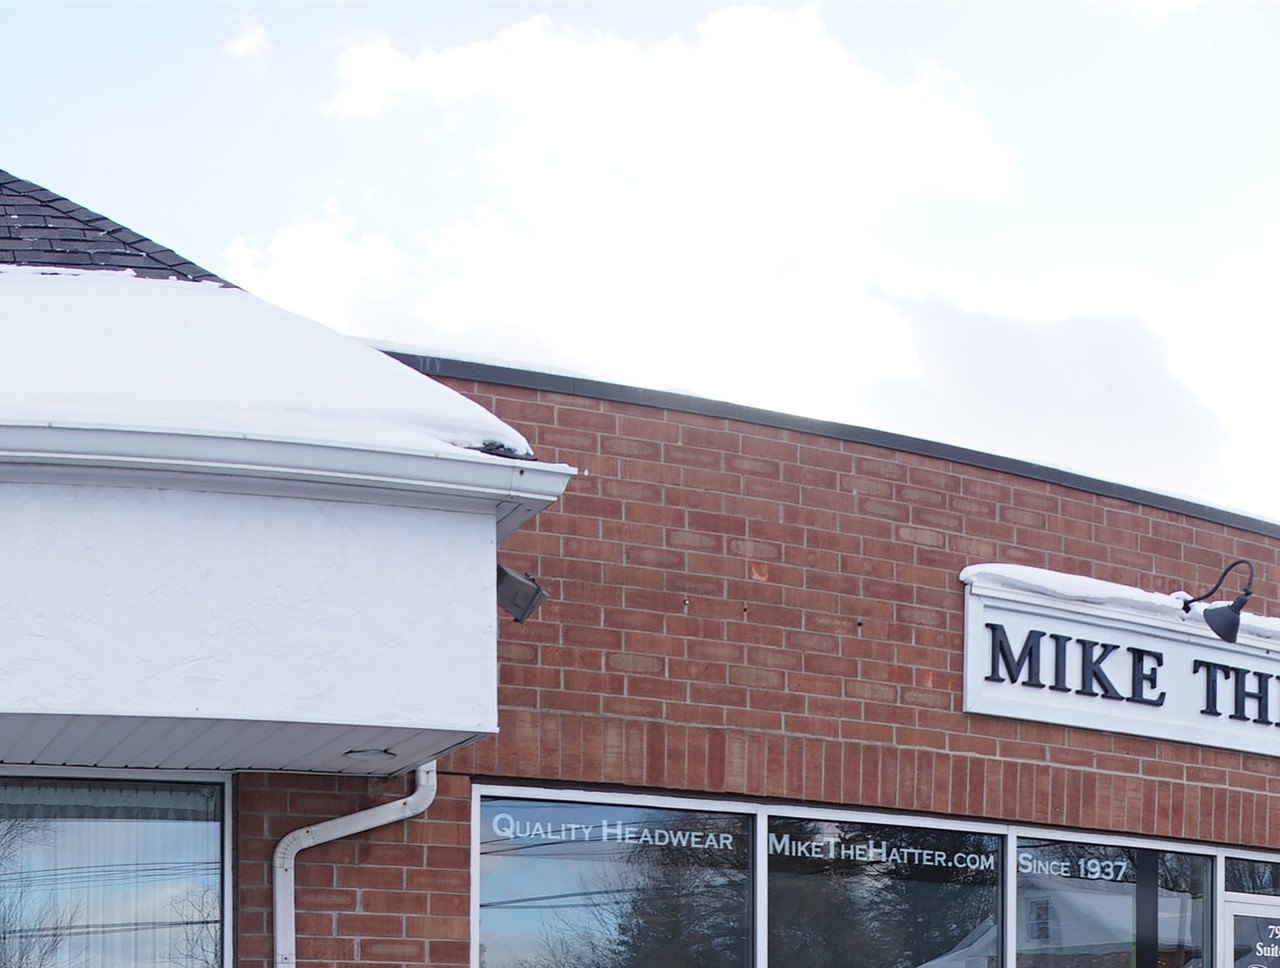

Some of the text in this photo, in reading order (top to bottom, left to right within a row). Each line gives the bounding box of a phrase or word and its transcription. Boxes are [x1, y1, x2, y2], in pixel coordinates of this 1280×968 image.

[985, 622, 1167, 708] MIKE
[492, 812, 734, 850] QUALITY HEADWEAR
[1018, 851, 1129, 882] SINCE 1937
